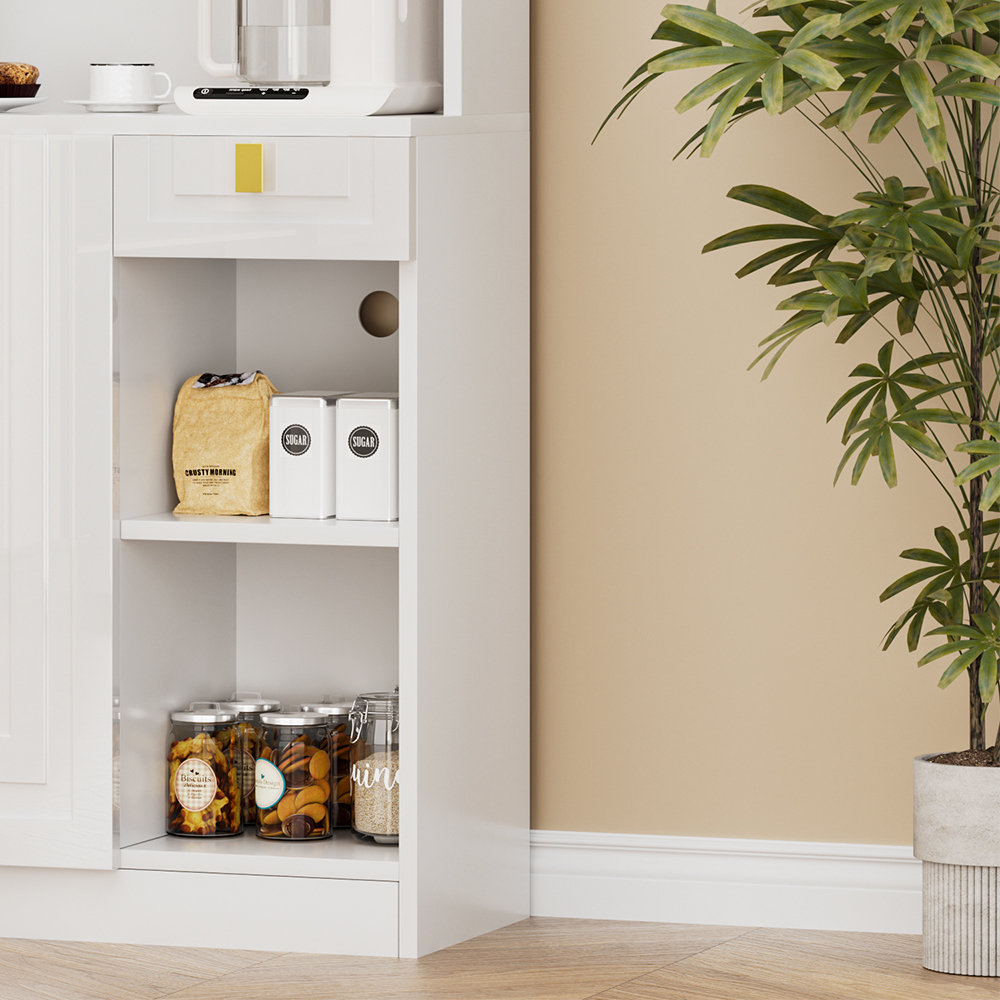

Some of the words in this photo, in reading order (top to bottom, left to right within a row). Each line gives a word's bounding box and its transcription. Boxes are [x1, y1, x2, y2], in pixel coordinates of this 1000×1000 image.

[285, 434, 307, 446] SUGAR
[352, 436, 375, 448] SUGAR
[185, 468, 209, 477] CRUSTY
[210, 468, 236, 477] MORNING
[180, 773, 212, 782] Biscuits
